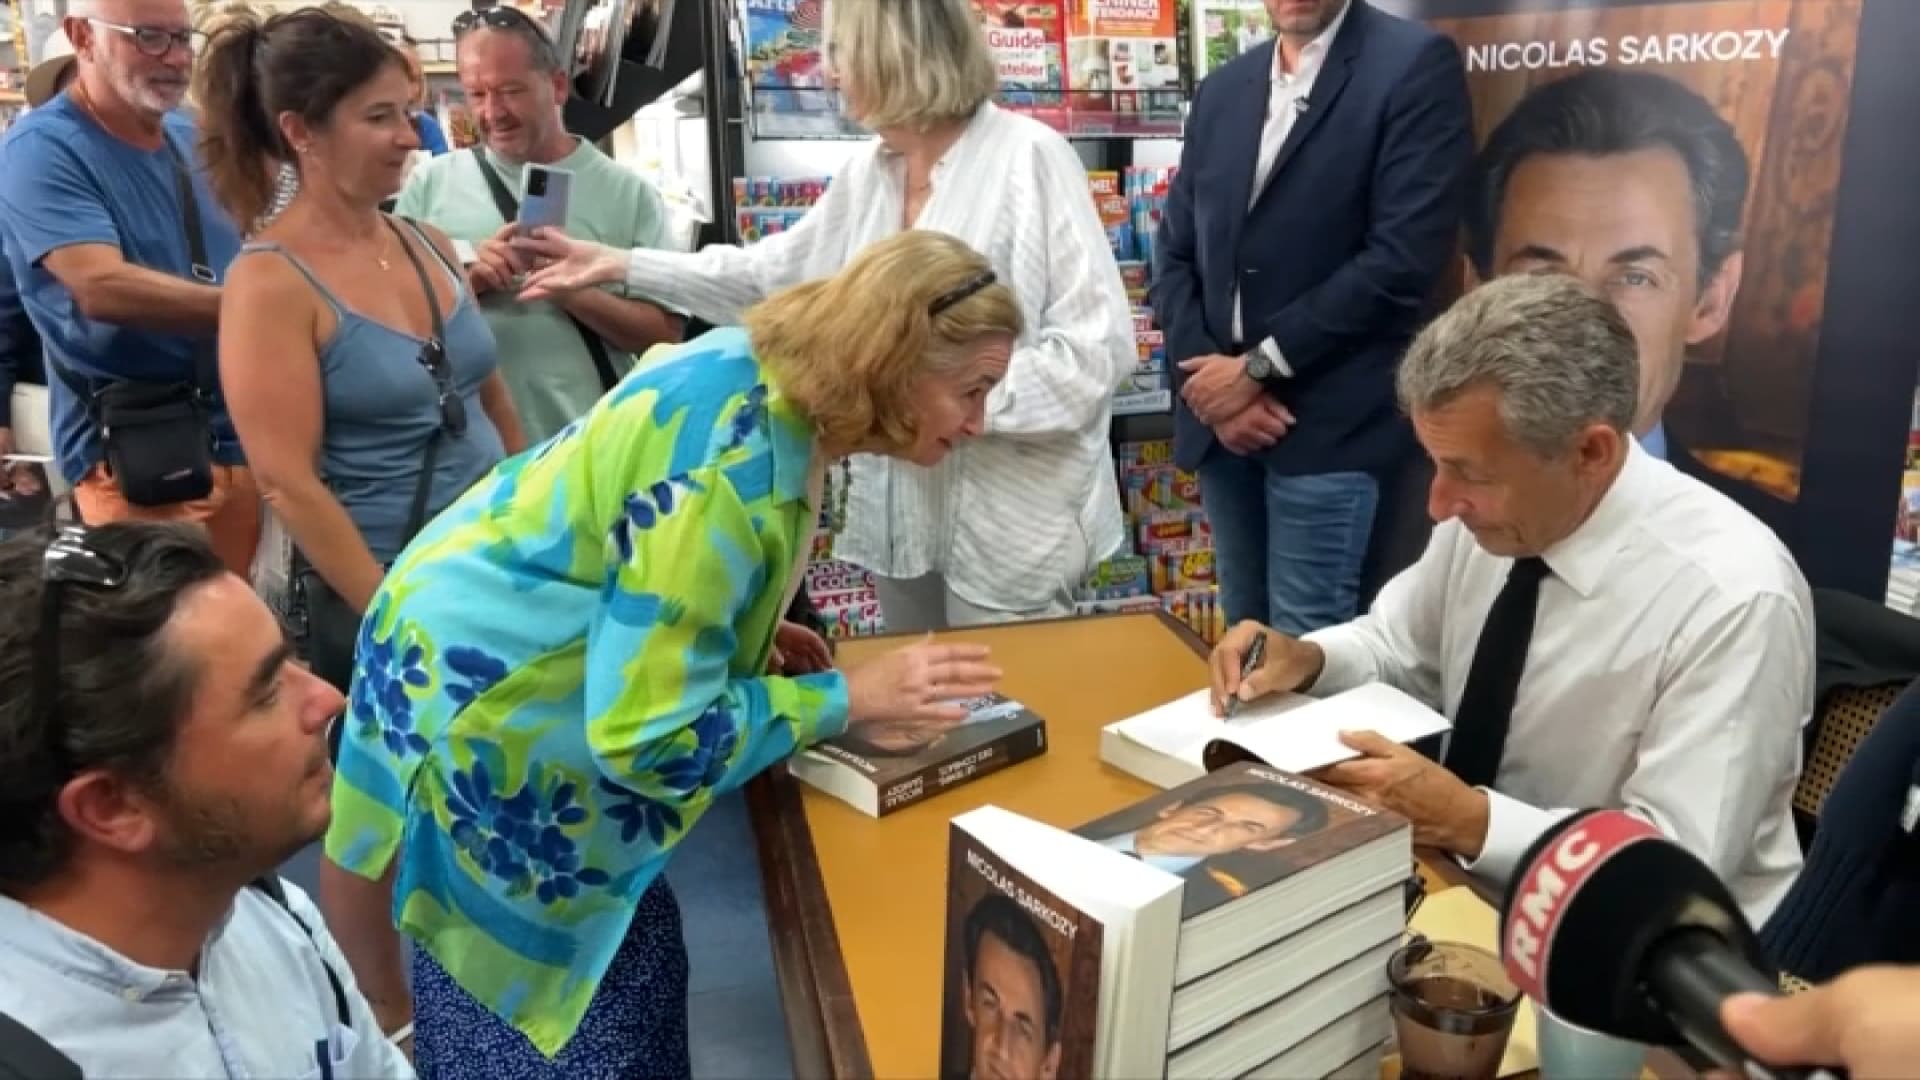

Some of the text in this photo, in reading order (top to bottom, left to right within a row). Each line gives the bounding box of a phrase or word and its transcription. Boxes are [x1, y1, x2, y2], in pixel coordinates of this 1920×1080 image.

[989, 31, 1044, 49] Guide
[1465, 28, 1790, 73] NICOLAS SARKOZY
[1246, 767, 1377, 817] NICOLAS SARKOZY
[966, 847, 1079, 940] NICOLAS SARKOZY
[1510, 829, 1601, 979] RMC
